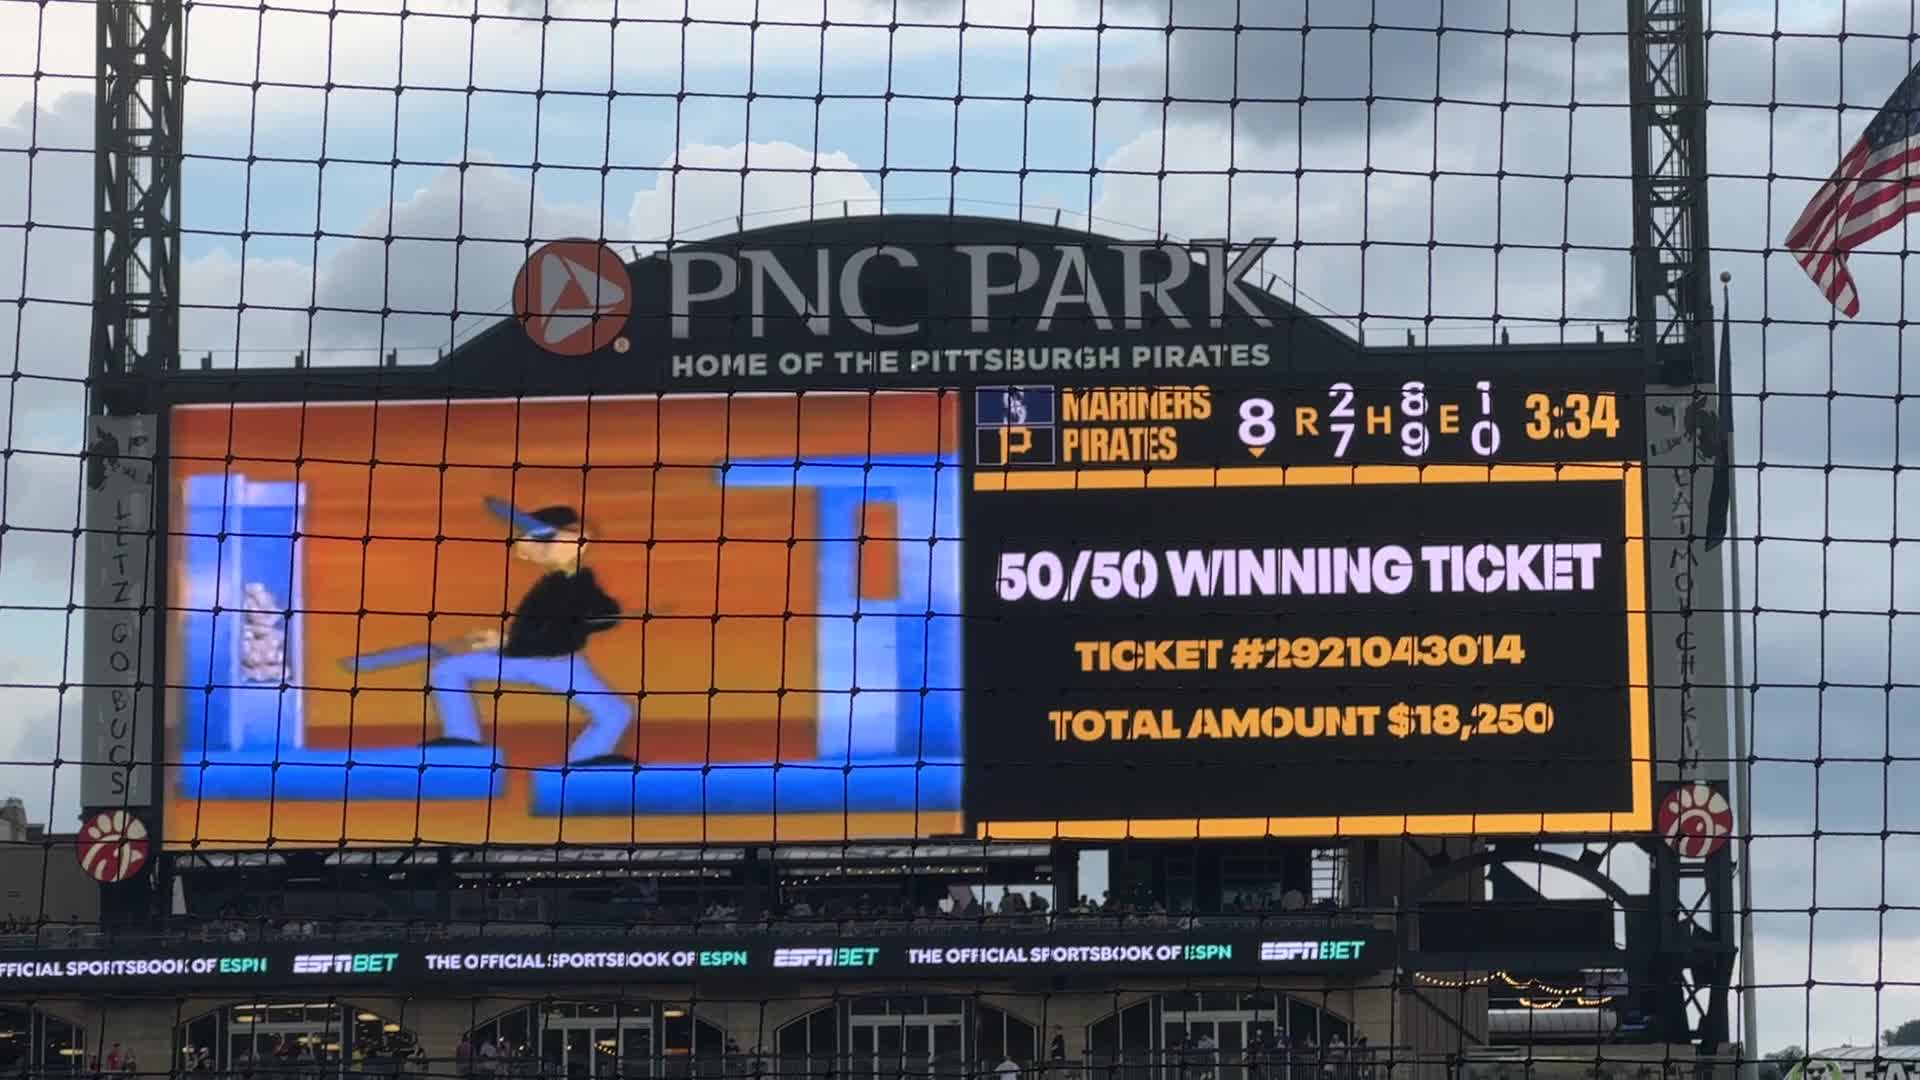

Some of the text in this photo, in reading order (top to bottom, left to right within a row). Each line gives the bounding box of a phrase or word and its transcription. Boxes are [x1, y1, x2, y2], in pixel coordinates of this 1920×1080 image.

[654, 237, 1277, 339] PNC PARK
[672, 343, 1271, 377] HOME OF THE PITTSBURGH PIRATES
[1062, 380, 1491, 421] MARINERS 2 8 1
[1237, 392, 1620, 446] 8 R H E 3:34
[1062, 419, 1501, 463] PIRATES 7 9 0
[996, 543, 1603, 602] 50/50 WINNING TICKET
[109, 623, 130, 672] GO
[1074, 634, 1526, 671] TICKET #2921043014
[109, 690, 128, 795] BUCS
[1048, 702, 1555, 742] TOTAL AMOUNT $18,250
[66, 959, 189, 977] SPORTSBOOK
[191, 958, 217, 974] OF
[219, 957, 267, 973] ESPN
[425, 951, 748, 970] THE OFFICIAL SPORTSBOOK OF ESPN
[908, 944, 1232, 964] THE OFFICIAL SPORTSBOOK OF ESPN
